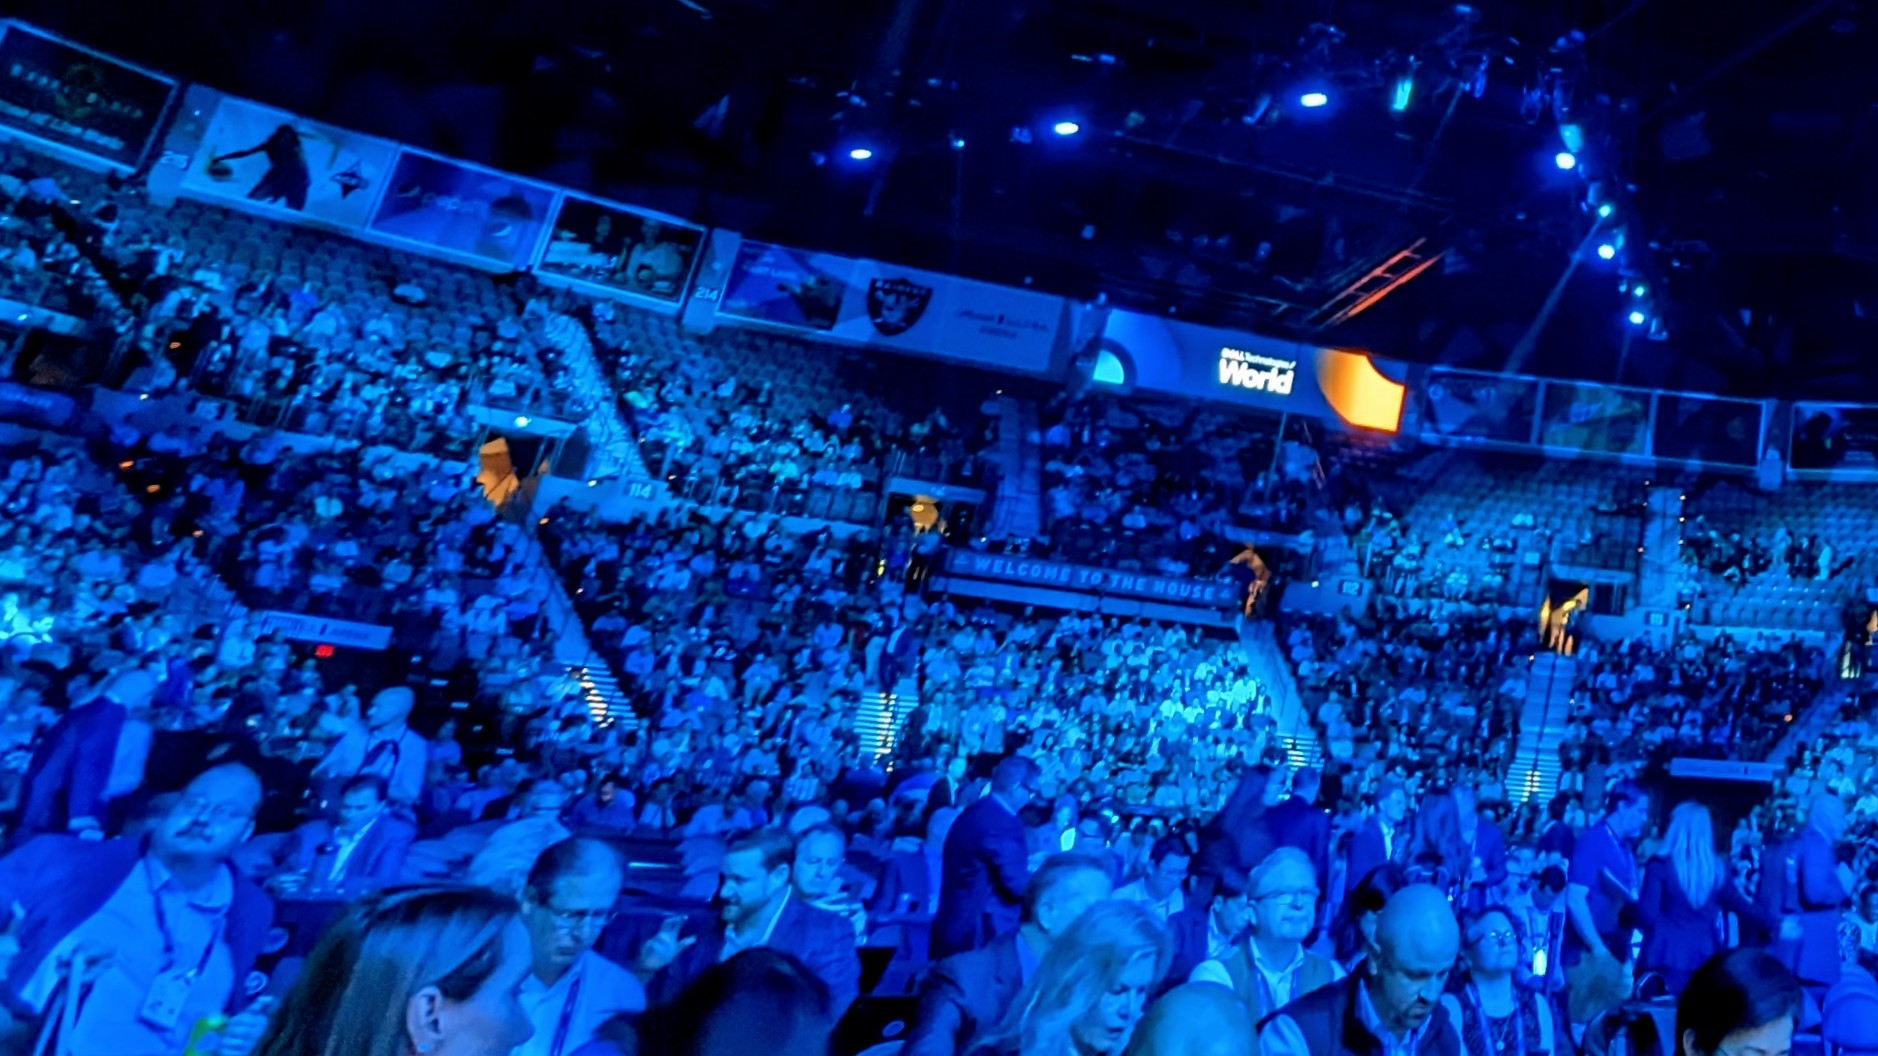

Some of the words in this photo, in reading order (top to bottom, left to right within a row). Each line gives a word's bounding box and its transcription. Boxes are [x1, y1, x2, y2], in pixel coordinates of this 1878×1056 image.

[1219, 358, 1294, 394] World
[975, 556, 1071, 582] WELCOME
[1079, 569, 1103, 585] TO
[1109, 573, 1147, 591] THE
[1153, 582, 1215, 601] HOUSE
